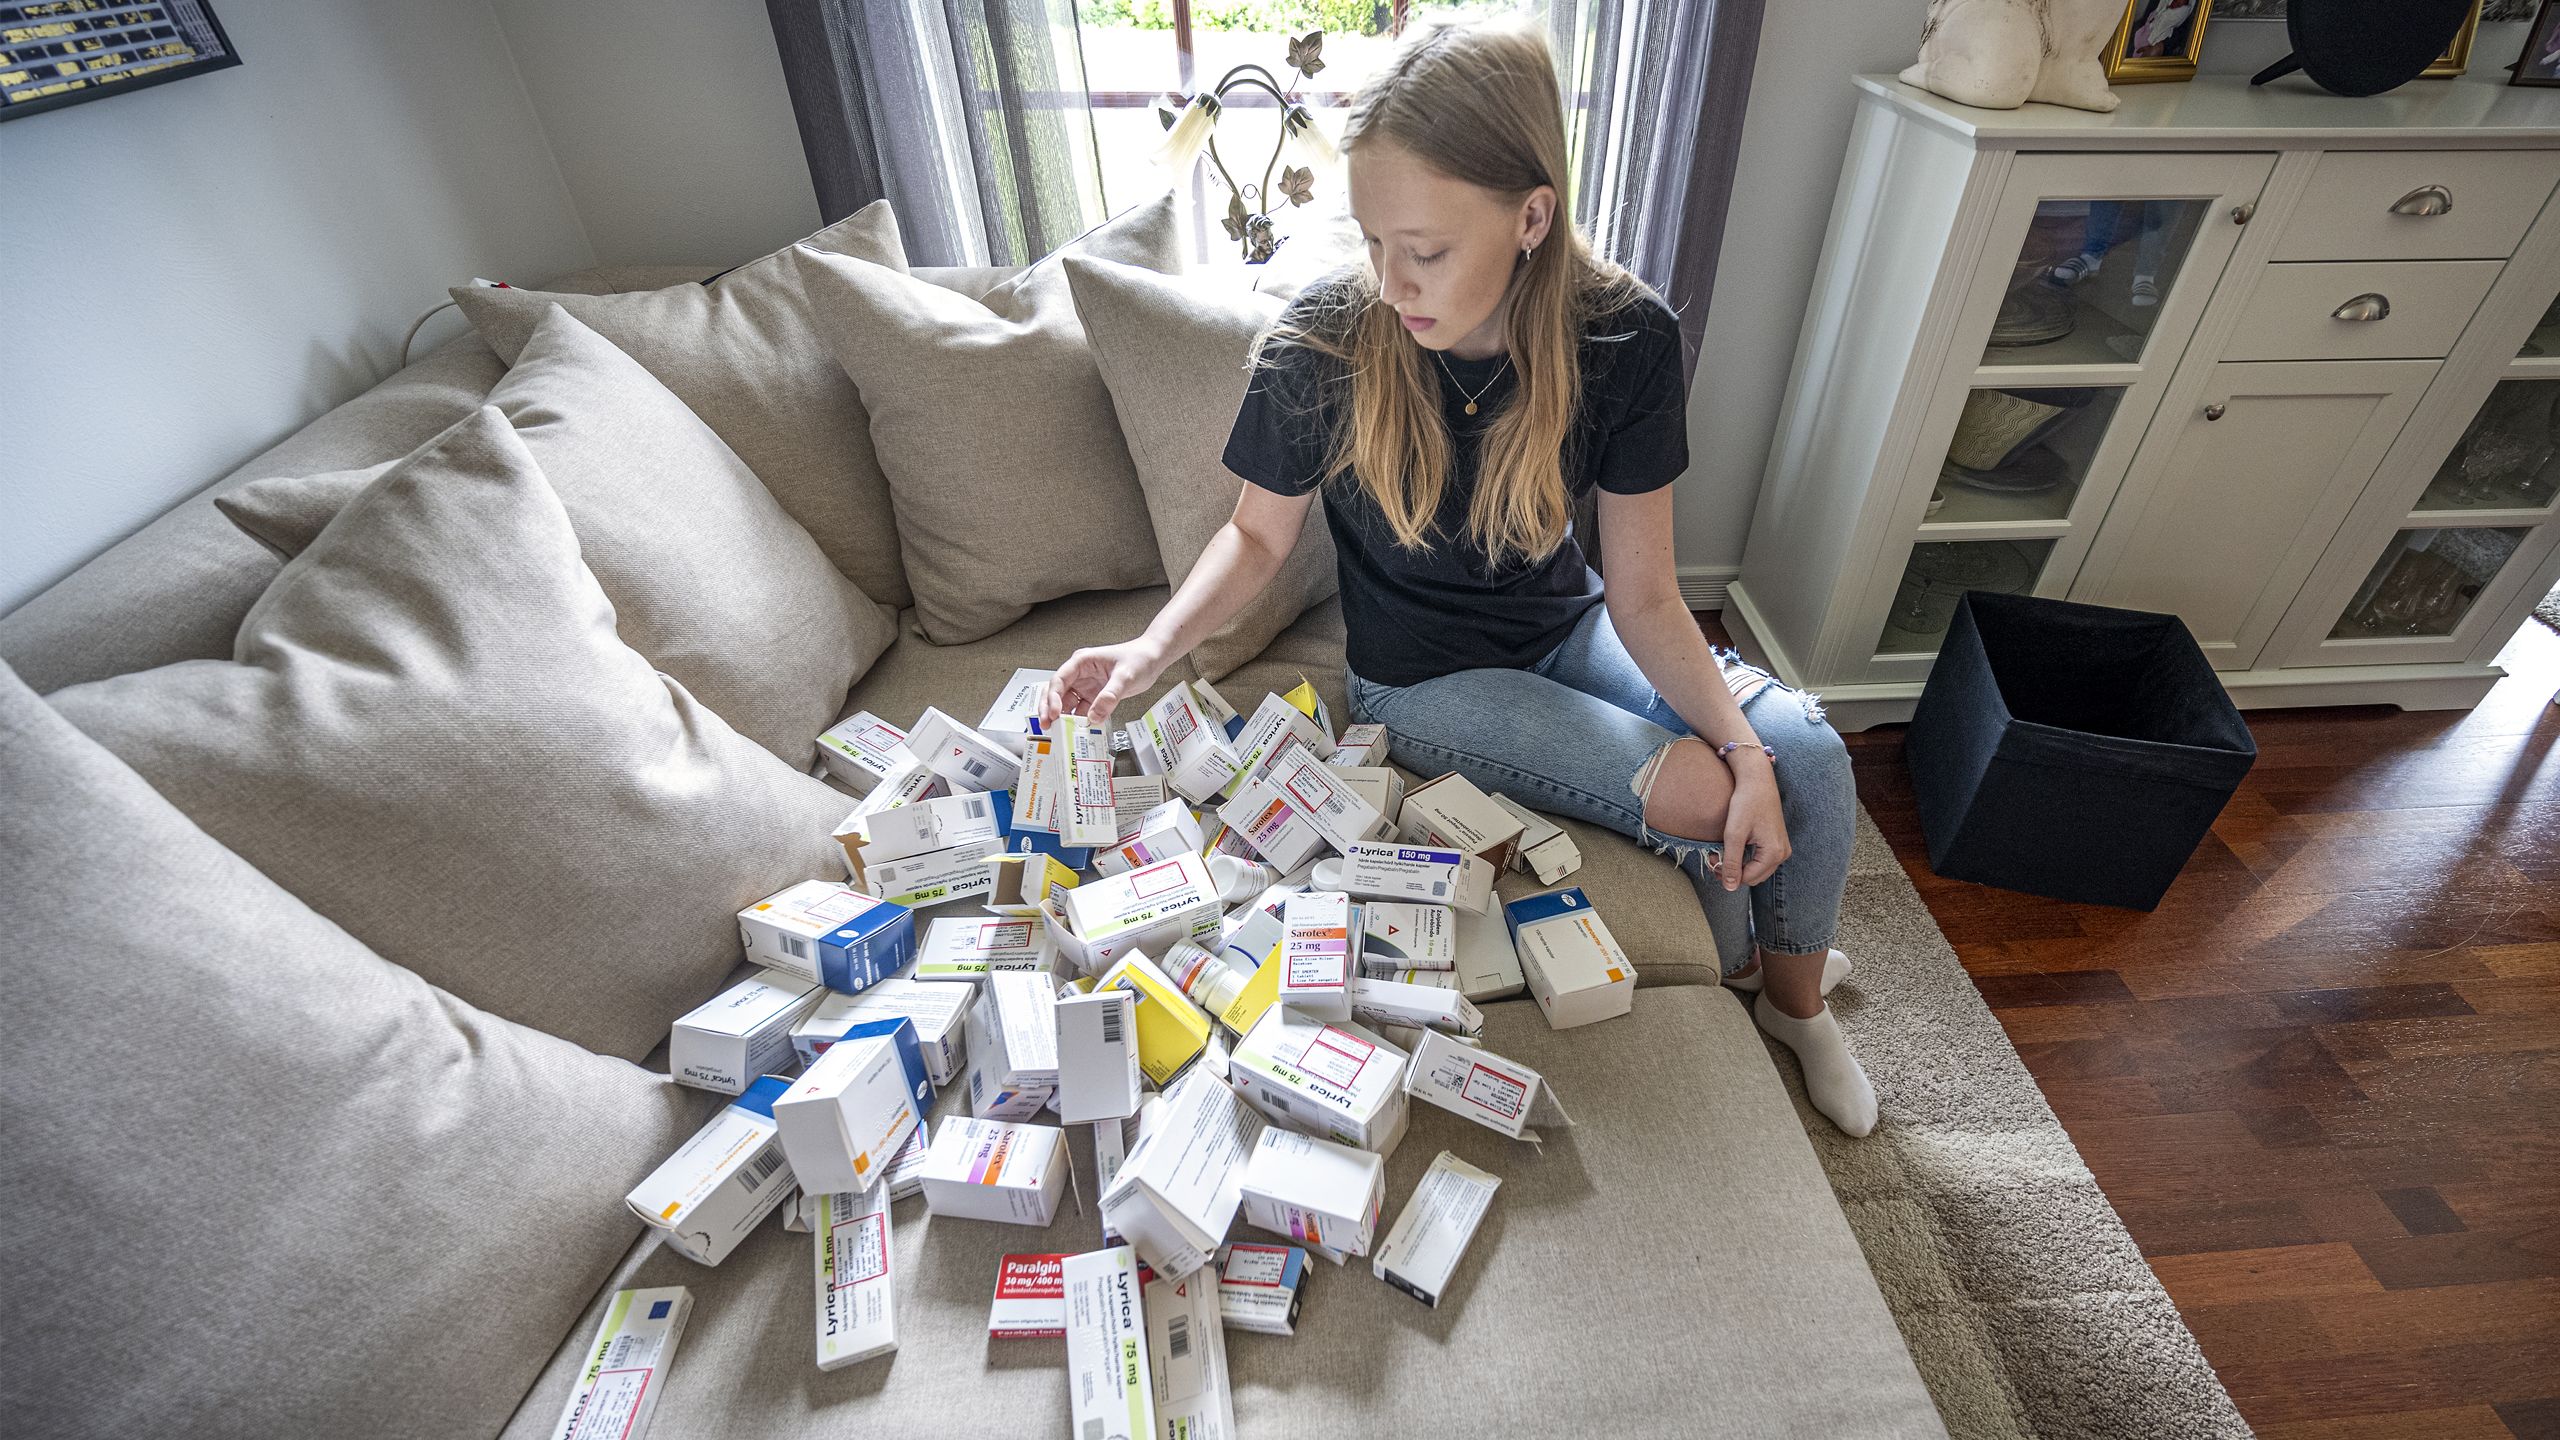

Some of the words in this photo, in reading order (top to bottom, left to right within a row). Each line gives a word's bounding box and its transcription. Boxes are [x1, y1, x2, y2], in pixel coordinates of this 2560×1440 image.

[1151, 728, 1161, 739] mg
[1260, 715, 1286, 747] Lyrica
[840, 743, 852, 753] mg
[850, 749, 859, 757] 75
[1251, 749, 1262, 761] 75
[861, 754, 886, 774] Lyrica
[1069, 752, 1077, 767] mg
[1158, 747, 1174, 770] Lyrica
[1211, 752, 1226, 764] Lyrica
[1242, 757, 1254, 771] mg
[1069, 767, 1077, 778] 75
[902, 771, 925, 799] Lyrica
[1025, 781, 1037, 818] NEURONTIN
[1035, 758, 1042, 769] mg
[1069, 787, 1086, 824] Lyrica
[1433, 806, 1443, 816] mg
[1247, 810, 1273, 835] Sarotex
[1256, 831, 1267, 843] 25
[1265, 820, 1279, 834] mg
[1359, 846, 1394, 857] Lyrica
[1400, 850, 1415, 858] 150
[1416, 852, 1431, 861] mg
[951, 877, 991, 893] Lyrica
[913, 890, 930, 901] mg
[931, 888, 943, 898] 75
[1159, 893, 1201, 915] Lyrica
[1122, 914, 1139, 926] mg
[1139, 910, 1153, 921] 75
[1191, 924, 1221, 939] Lyrica
[1580, 916, 1602, 948] NEURONTIN
[1290, 942, 1302, 951] 25
[1306, 942, 1321, 952] mg
[1427, 947, 1432, 956] mg
[993, 963, 1035, 972] Lyrica
[683, 1068, 697, 1077] mg
[698, 1072, 708, 1080] 75
[1270, 1063, 1288, 1078] mg
[712, 1075, 736, 1085] Lyrica
[1287, 1072, 1302, 1085] 75
[1308, 1082, 1352, 1109] Lyrica
[987, 1127, 998, 1141] 25
[978, 1141, 993, 1160] mg
[993, 1127, 1014, 1166] Sarotex
[823, 1235, 833, 1255] mg
[823, 1257, 835, 1272] 75
[1007, 1261, 1059, 1278] Paralgin
[1005, 1277, 1019, 1285] 30
[1021, 1277, 1052, 1287] mg/400
[1116, 1271, 1133, 1328] Lyrica
[821, 1282, 839, 1336] Lyrica
[1124, 1341, 1137, 1360] 75
[585, 1362, 601, 1383] 75
[595, 1338, 611, 1361] mg
[1124, 1362, 1139, 1385] mg
